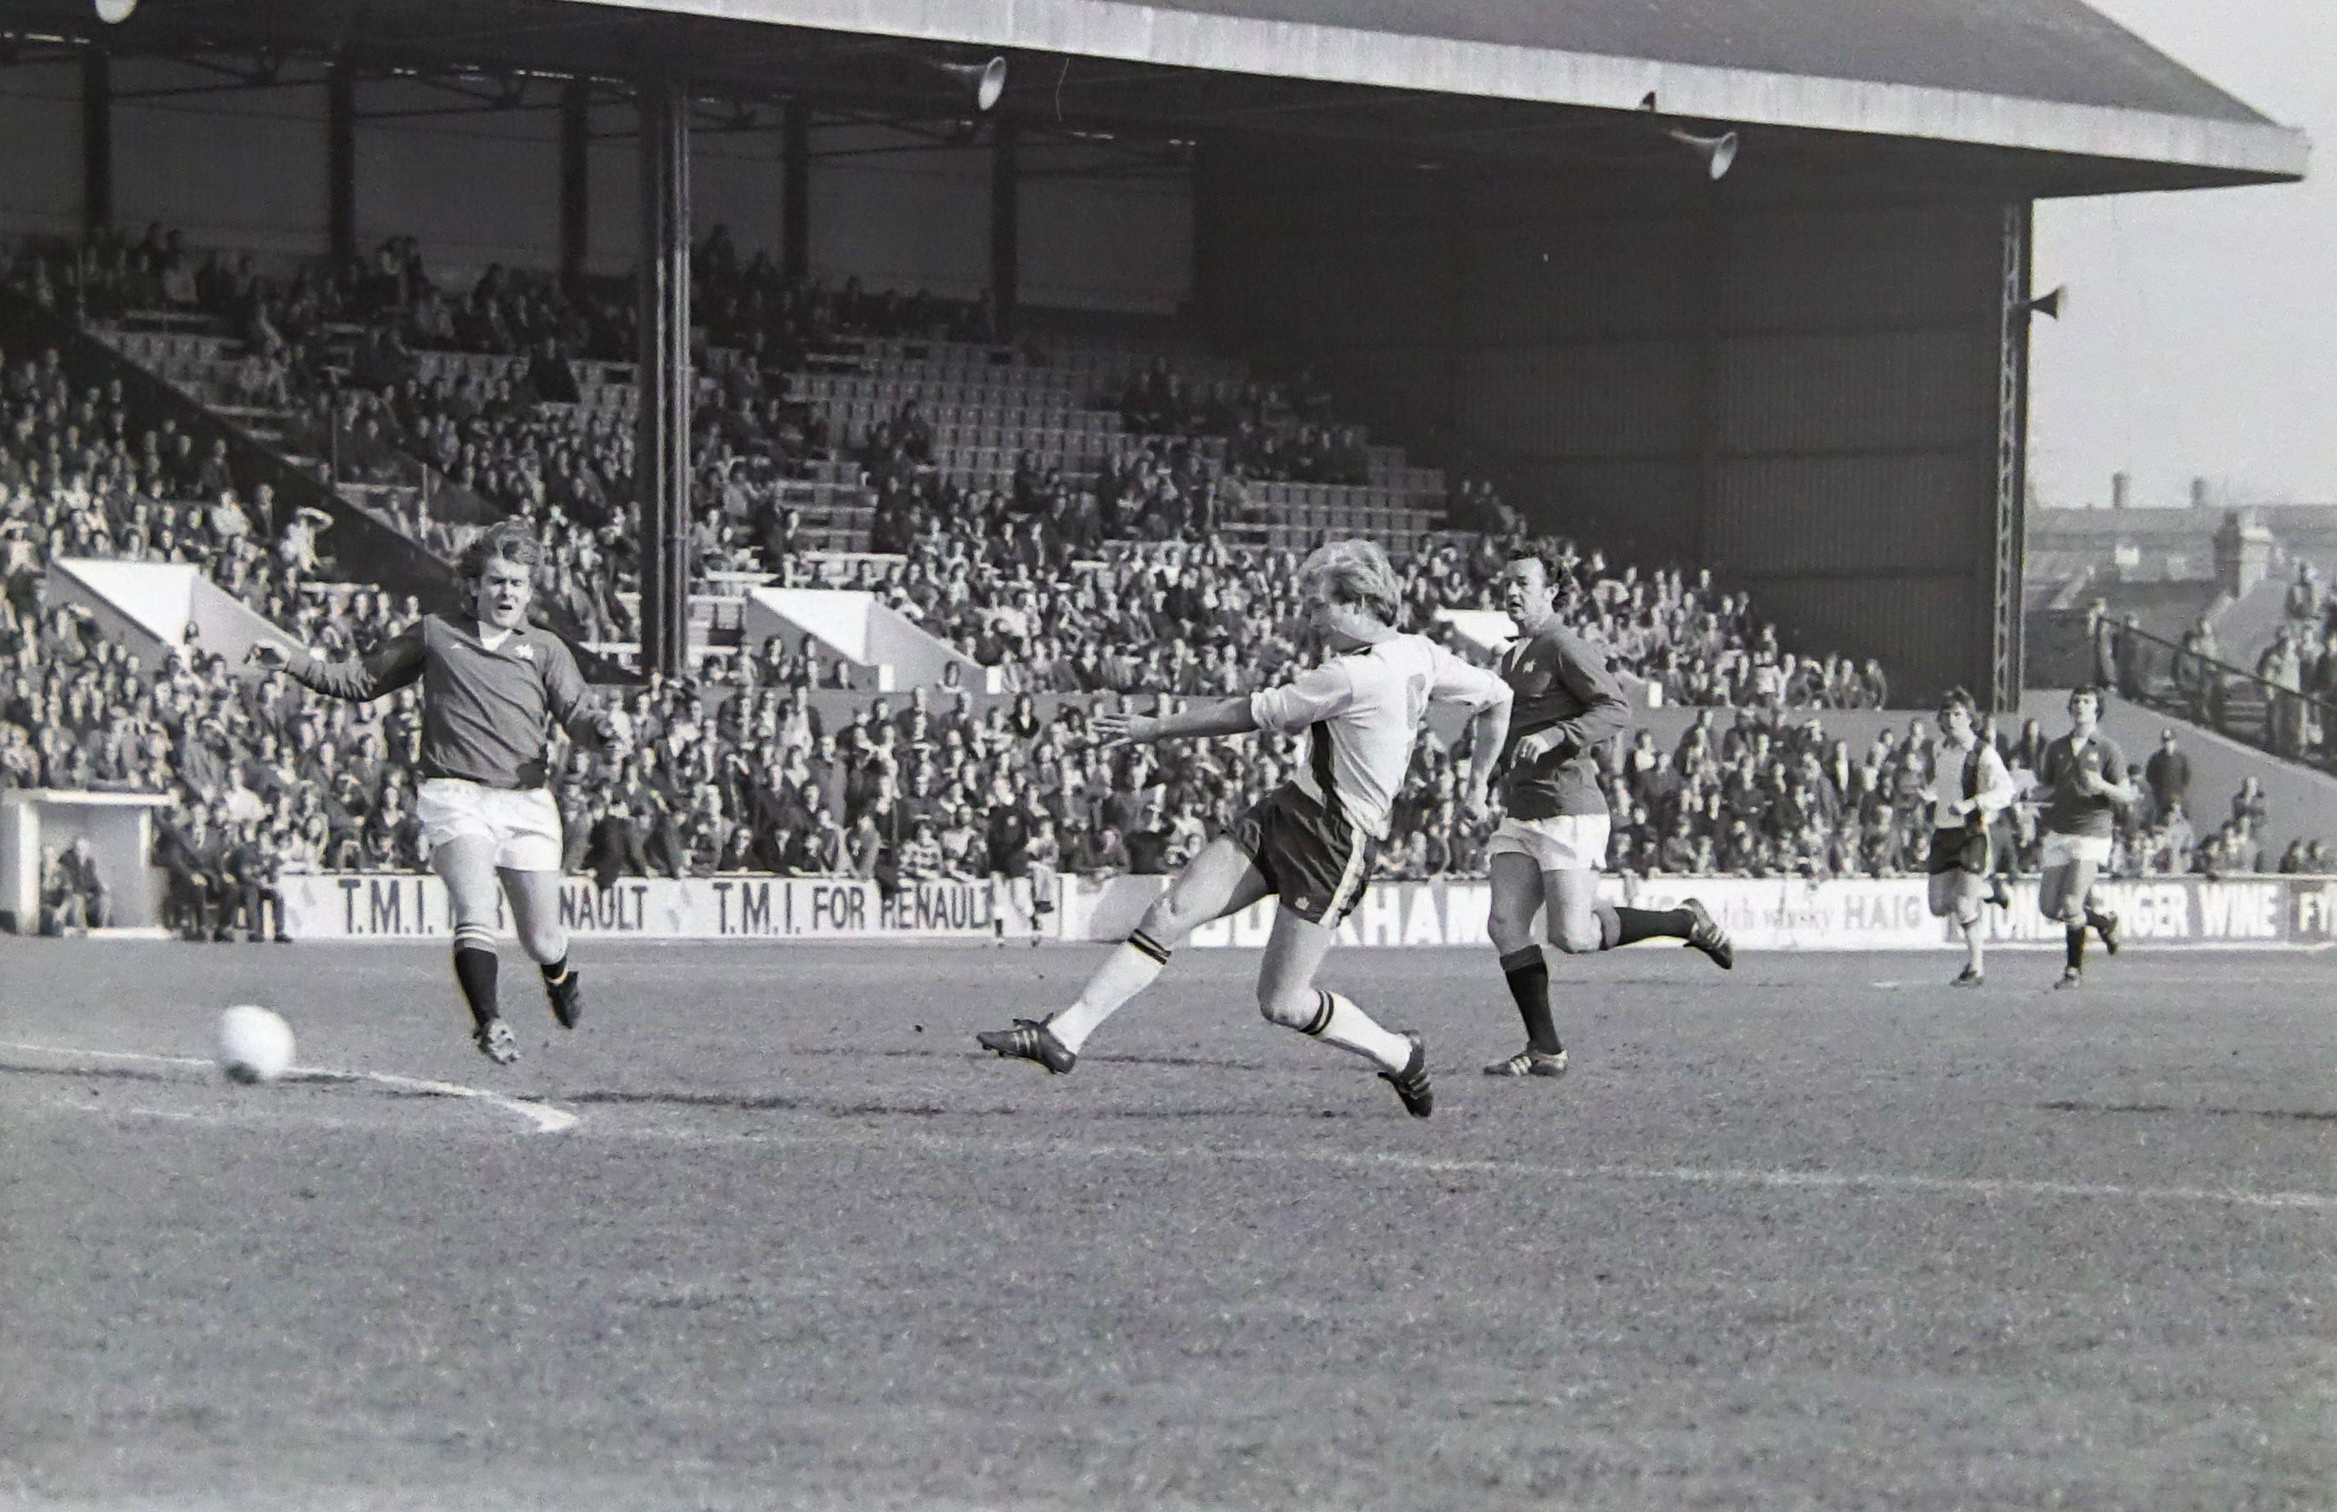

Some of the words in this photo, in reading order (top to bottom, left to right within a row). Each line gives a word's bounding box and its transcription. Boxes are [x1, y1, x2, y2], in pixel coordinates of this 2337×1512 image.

[337, 878, 433, 934] T.M.I.
[559, 885, 648, 931] NAULT
[713, 881, 801, 935] T.M.I.
[813, 886, 865, 930] FOR
[881, 884, 993, 931] RENAULT
[1844, 895, 1922, 931] HAIG
[2197, 884, 2279, 938] WINE
